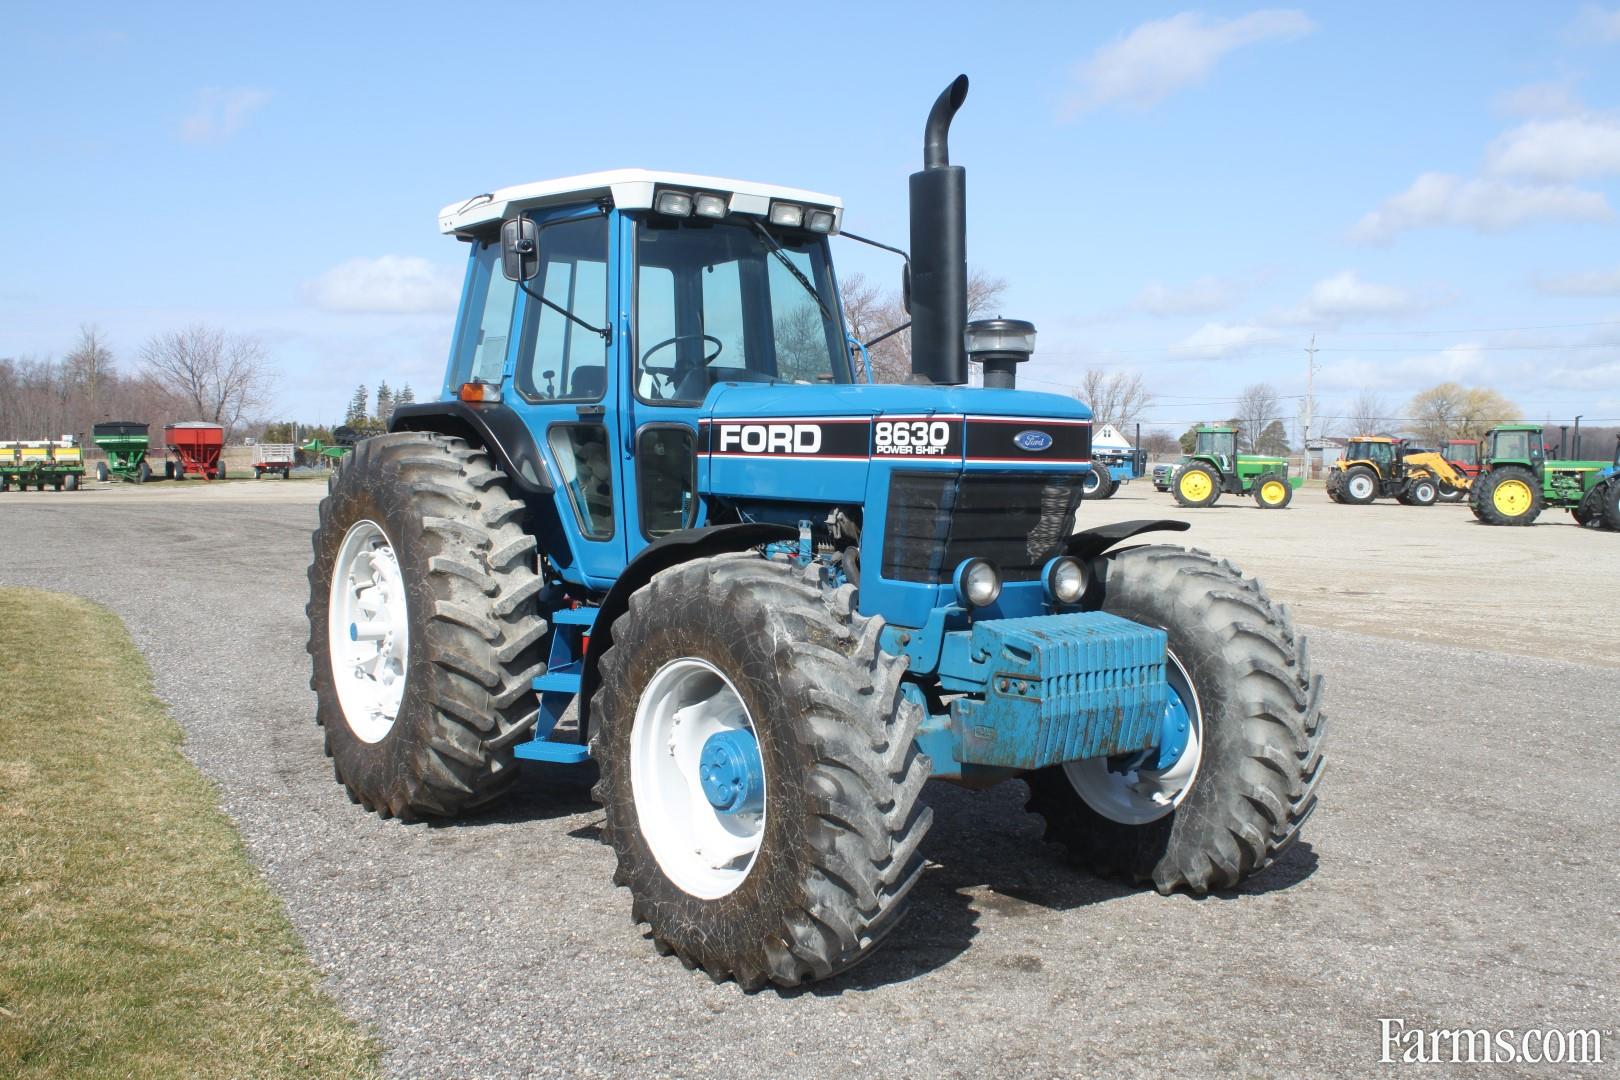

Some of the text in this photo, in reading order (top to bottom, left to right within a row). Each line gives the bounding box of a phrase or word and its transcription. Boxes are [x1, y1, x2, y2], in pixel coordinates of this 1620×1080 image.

[720, 424, 822, 453] FORD
[875, 421, 950, 446] 8630
[876, 445, 947, 455] POWER SHIFT
